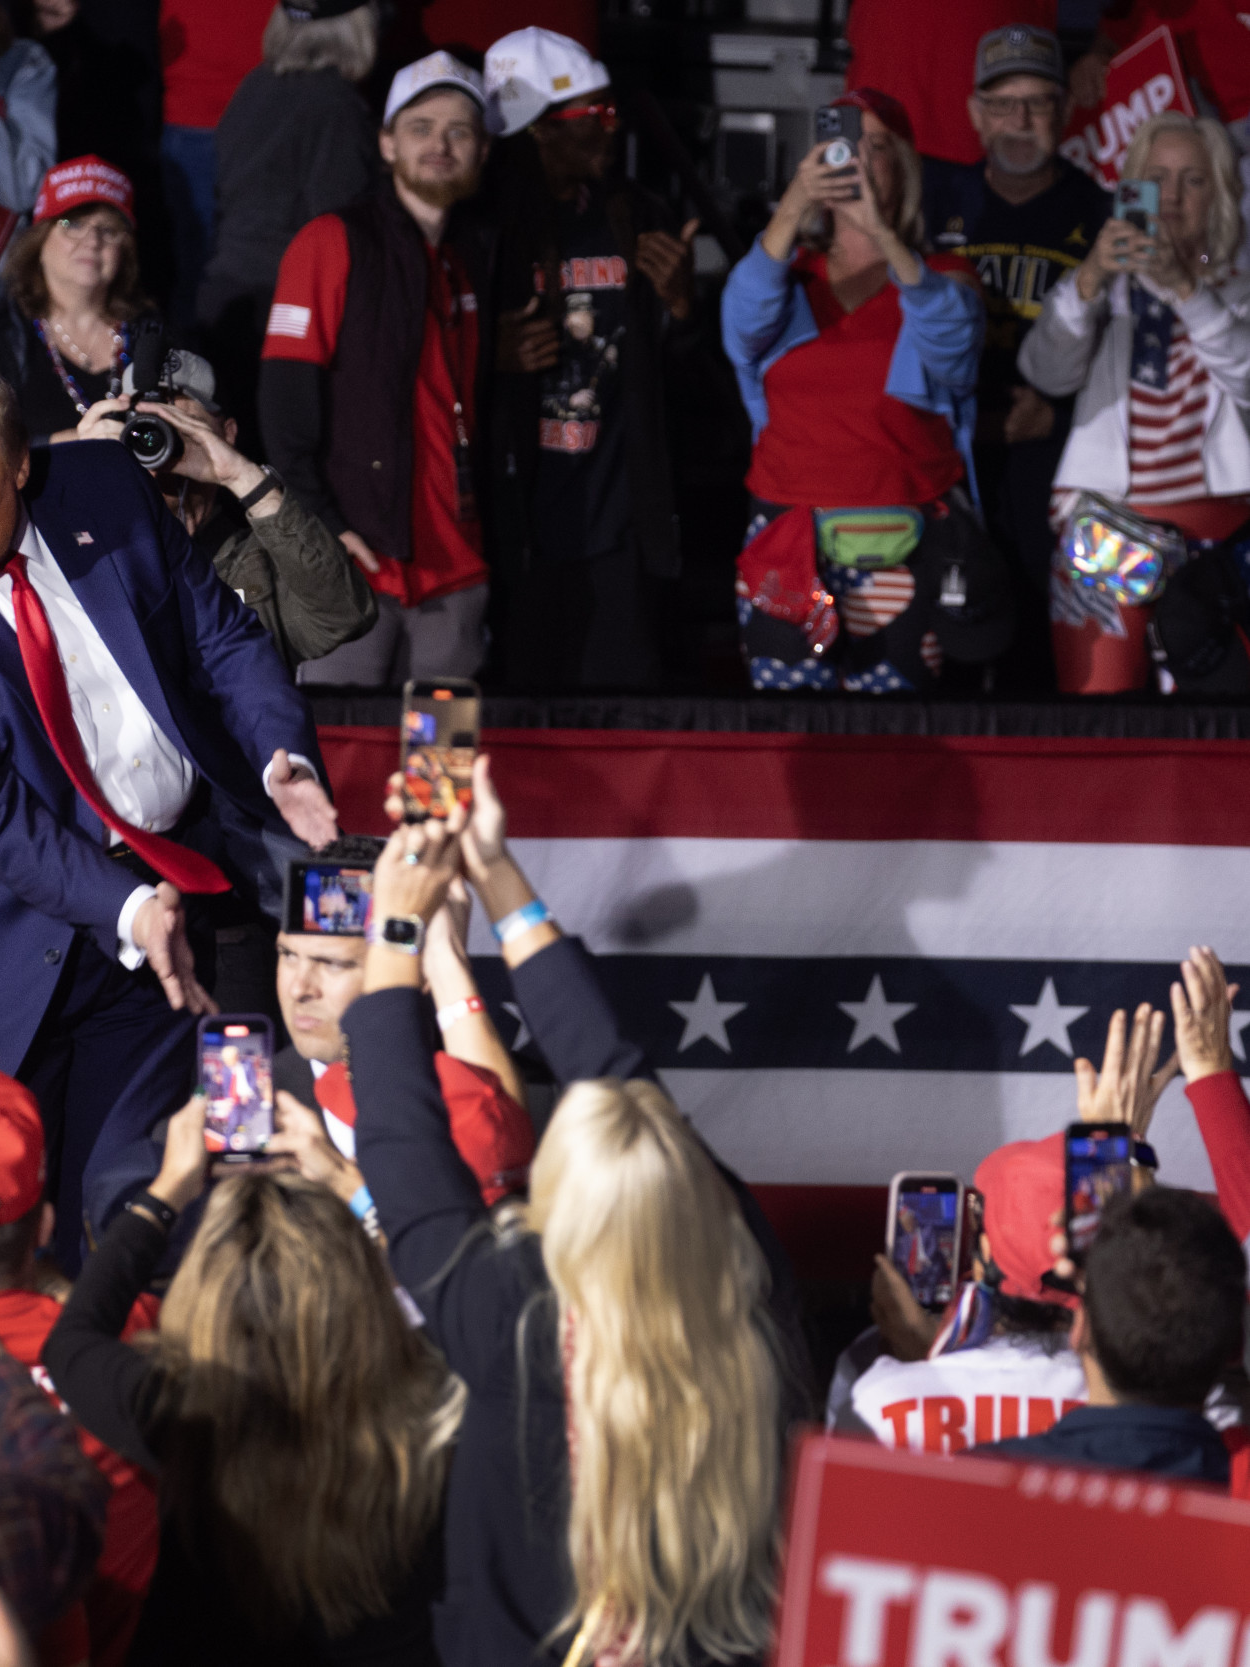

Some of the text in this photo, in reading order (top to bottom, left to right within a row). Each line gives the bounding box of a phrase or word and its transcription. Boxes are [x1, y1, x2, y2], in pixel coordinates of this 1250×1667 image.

[1059, 73, 1176, 174] RUMP
[881, 1395, 1087, 1453] TRU
[822, 1555, 1250, 1667] TRUM
